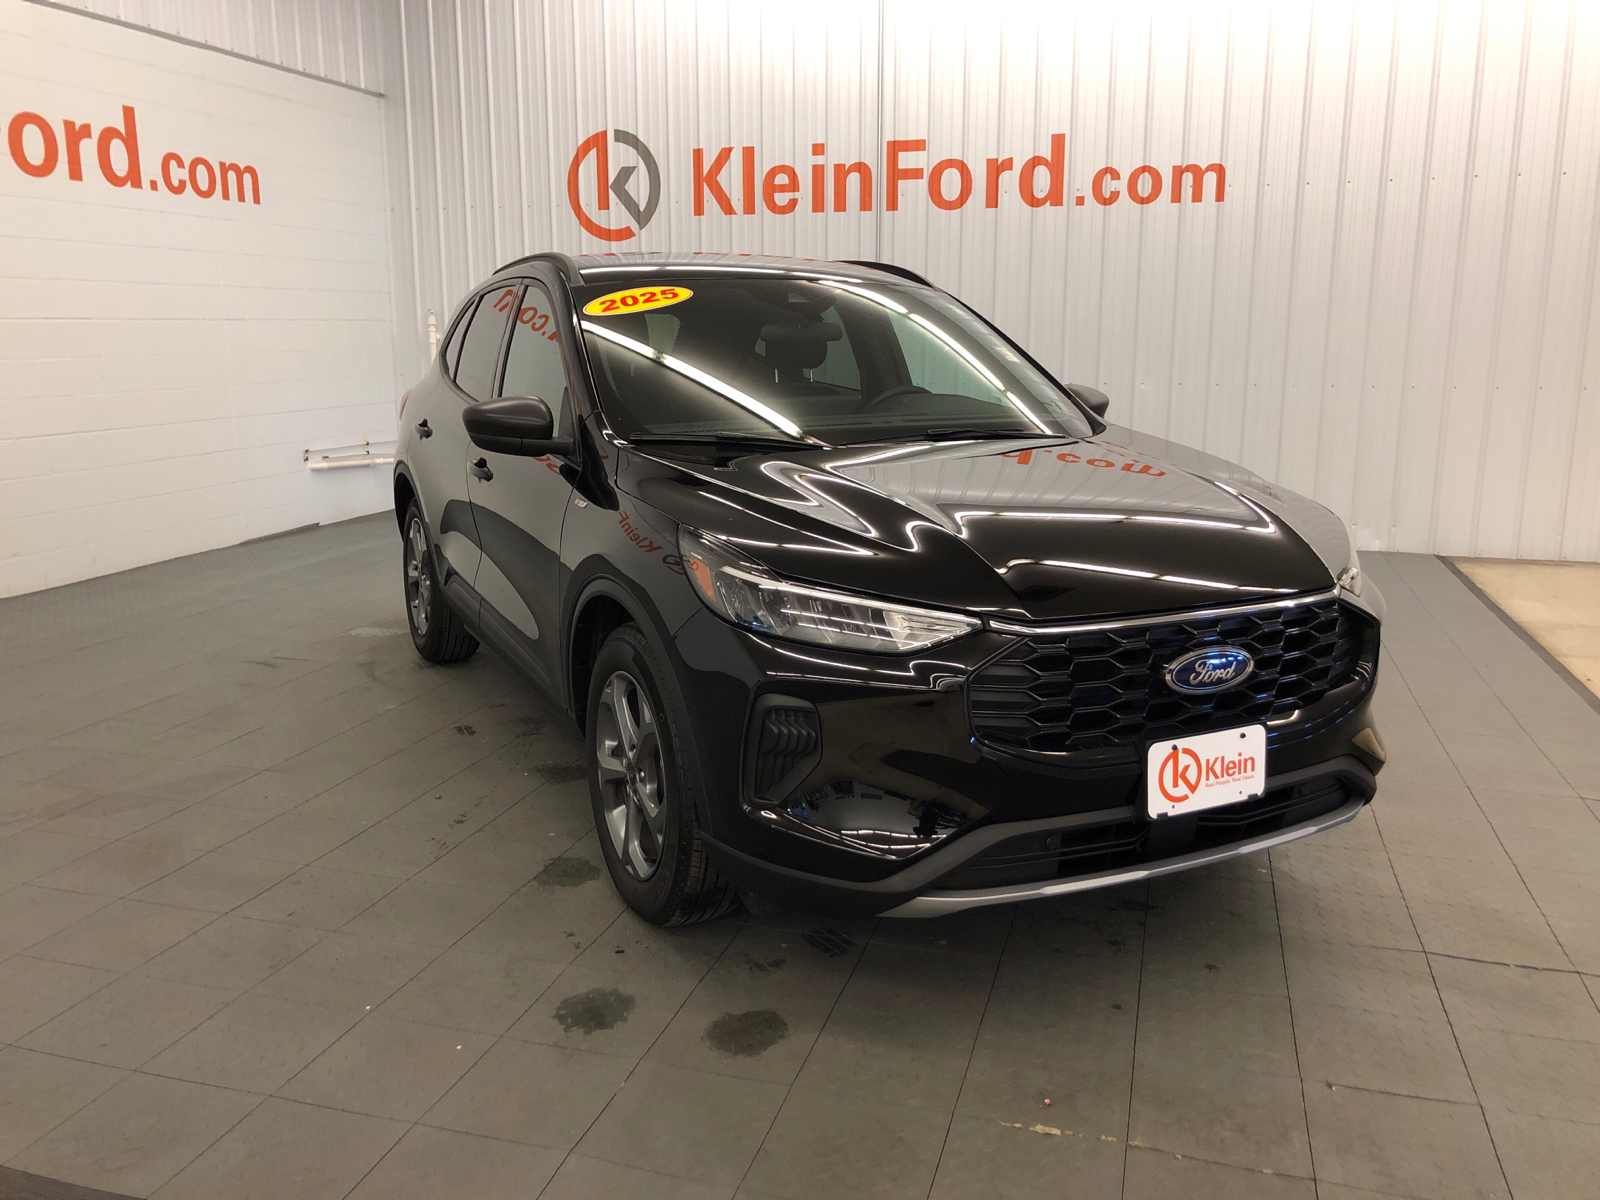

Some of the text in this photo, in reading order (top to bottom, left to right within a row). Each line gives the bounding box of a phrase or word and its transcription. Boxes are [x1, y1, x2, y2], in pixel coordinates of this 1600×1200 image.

[0, 104, 261, 205] ord.com
[691, 132, 1227, 217] KleinFord.com
[599, 288, 679, 313] 2025
[1190, 660, 1236, 684] Ford
[1205, 752, 1255, 781] Klein
